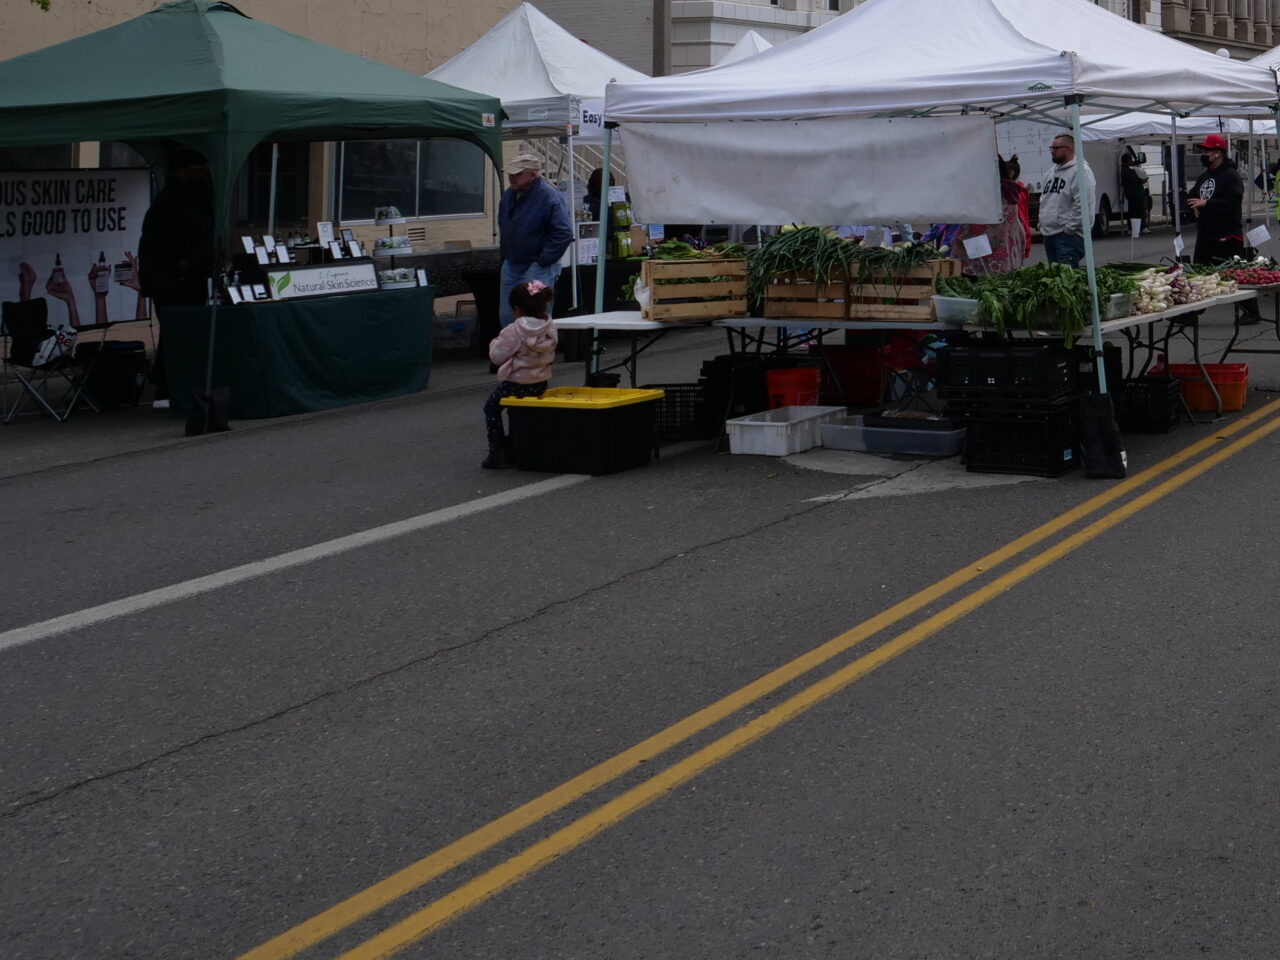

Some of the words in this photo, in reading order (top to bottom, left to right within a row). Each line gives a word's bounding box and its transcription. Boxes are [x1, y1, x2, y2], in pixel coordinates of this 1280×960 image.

[583, 110, 602, 128] Easy
[31, 179, 70, 205] SKIN
[76, 178, 118, 204] CARE
[1043, 177, 1066, 195] GAP
[22, 209, 66, 236] GOOD
[71, 208, 91, 234] TO
[96, 207, 127, 232] USE
[293, 280, 326, 293] Natural
[326, 278, 344, 290] Skin
[345, 276, 376, 289] Science
